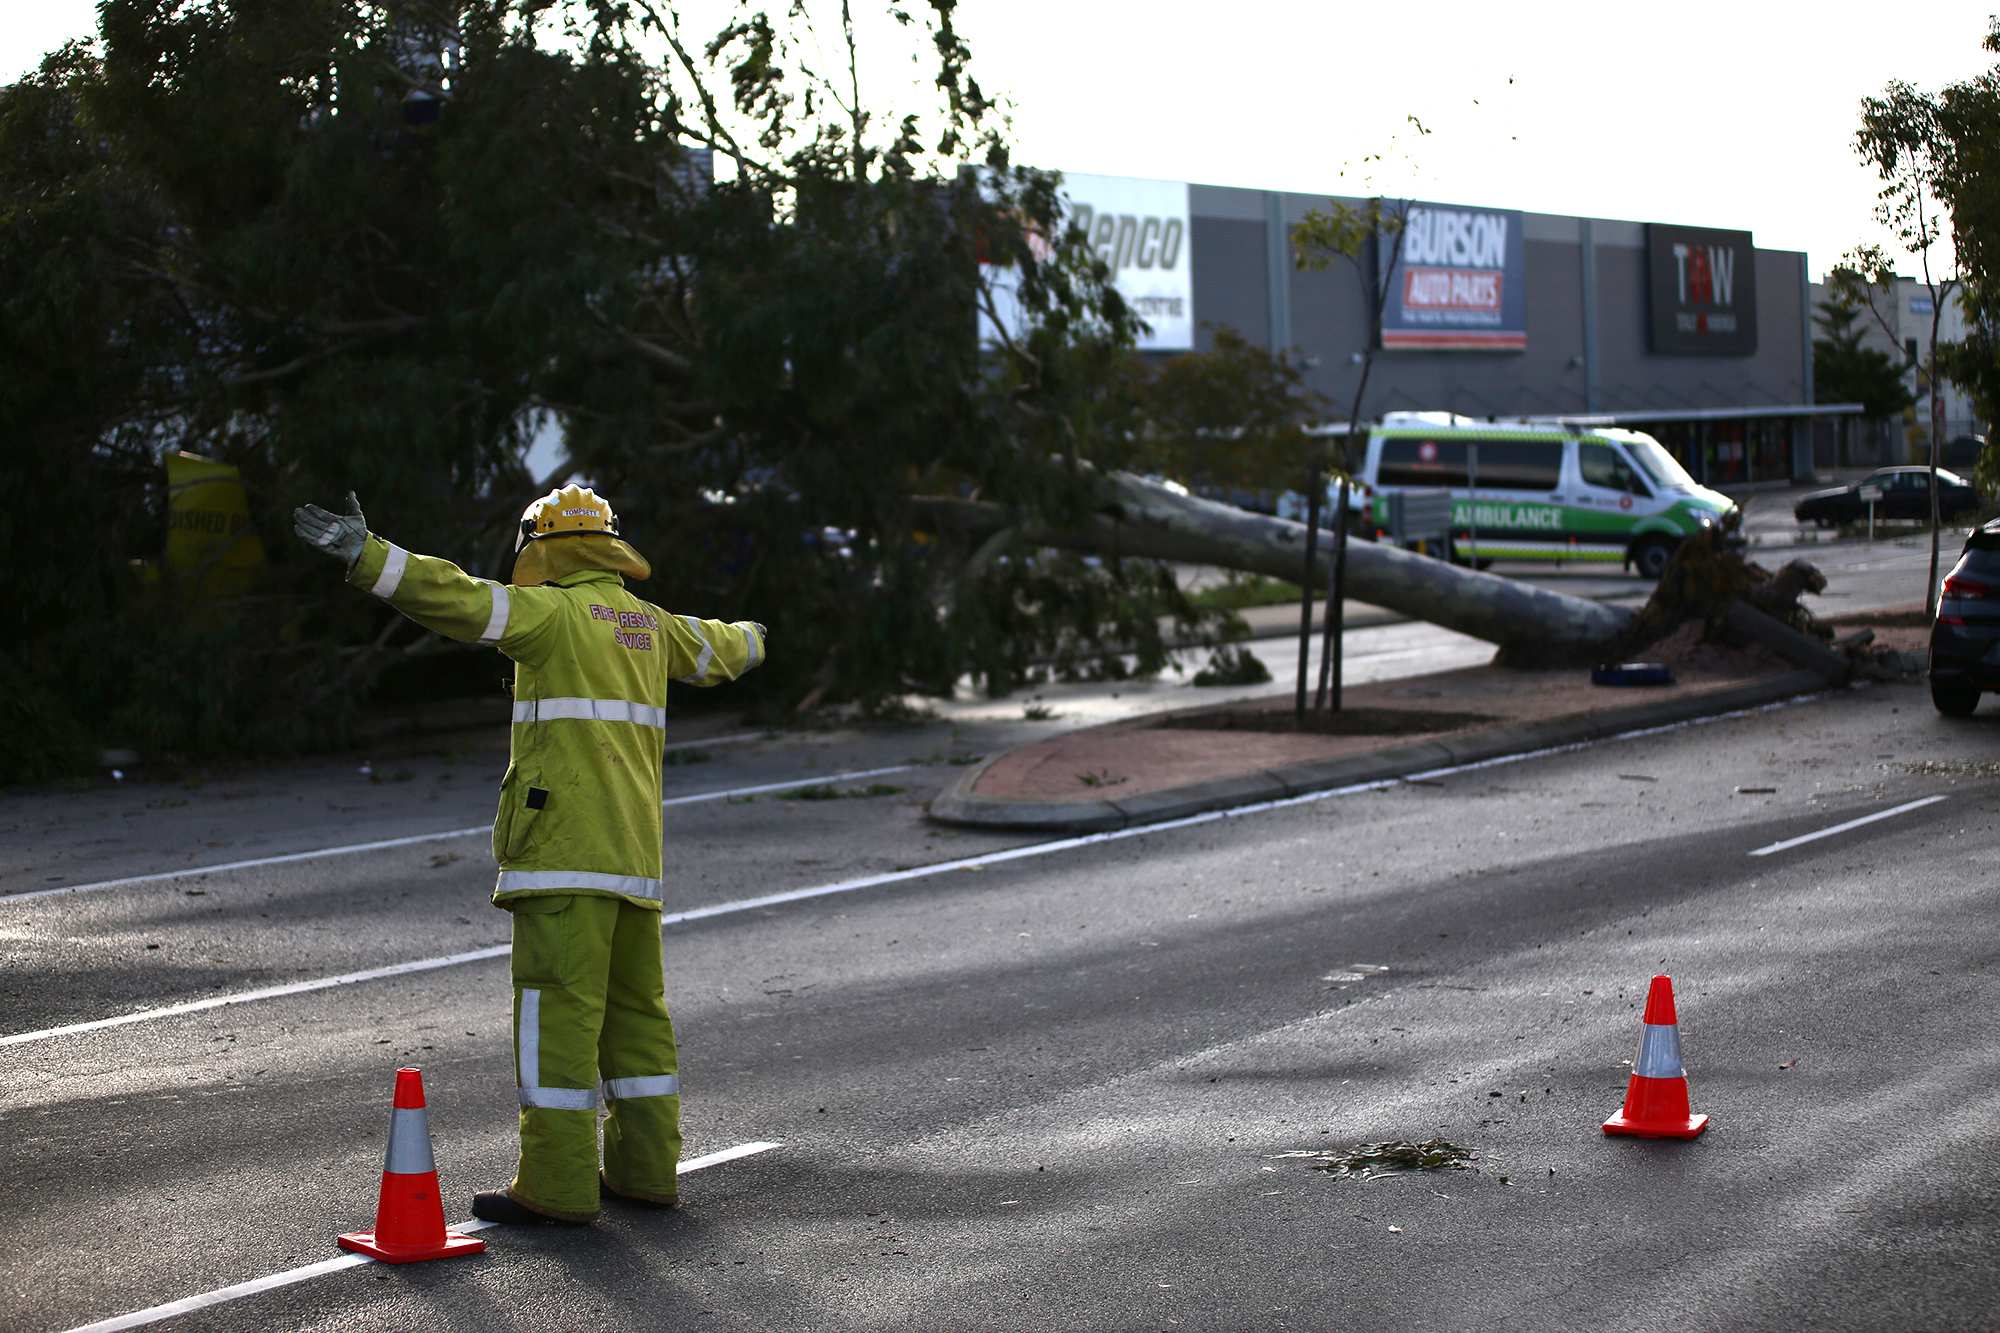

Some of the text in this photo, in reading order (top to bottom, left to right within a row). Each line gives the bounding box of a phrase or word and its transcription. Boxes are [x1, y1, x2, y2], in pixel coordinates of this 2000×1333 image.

[1405, 207, 1507, 267] BURSON
[1408, 271, 1497, 308] AUTO PARTS
[1454, 504, 1563, 529] AMBULANCE
[589, 604, 618, 623] FIRE
